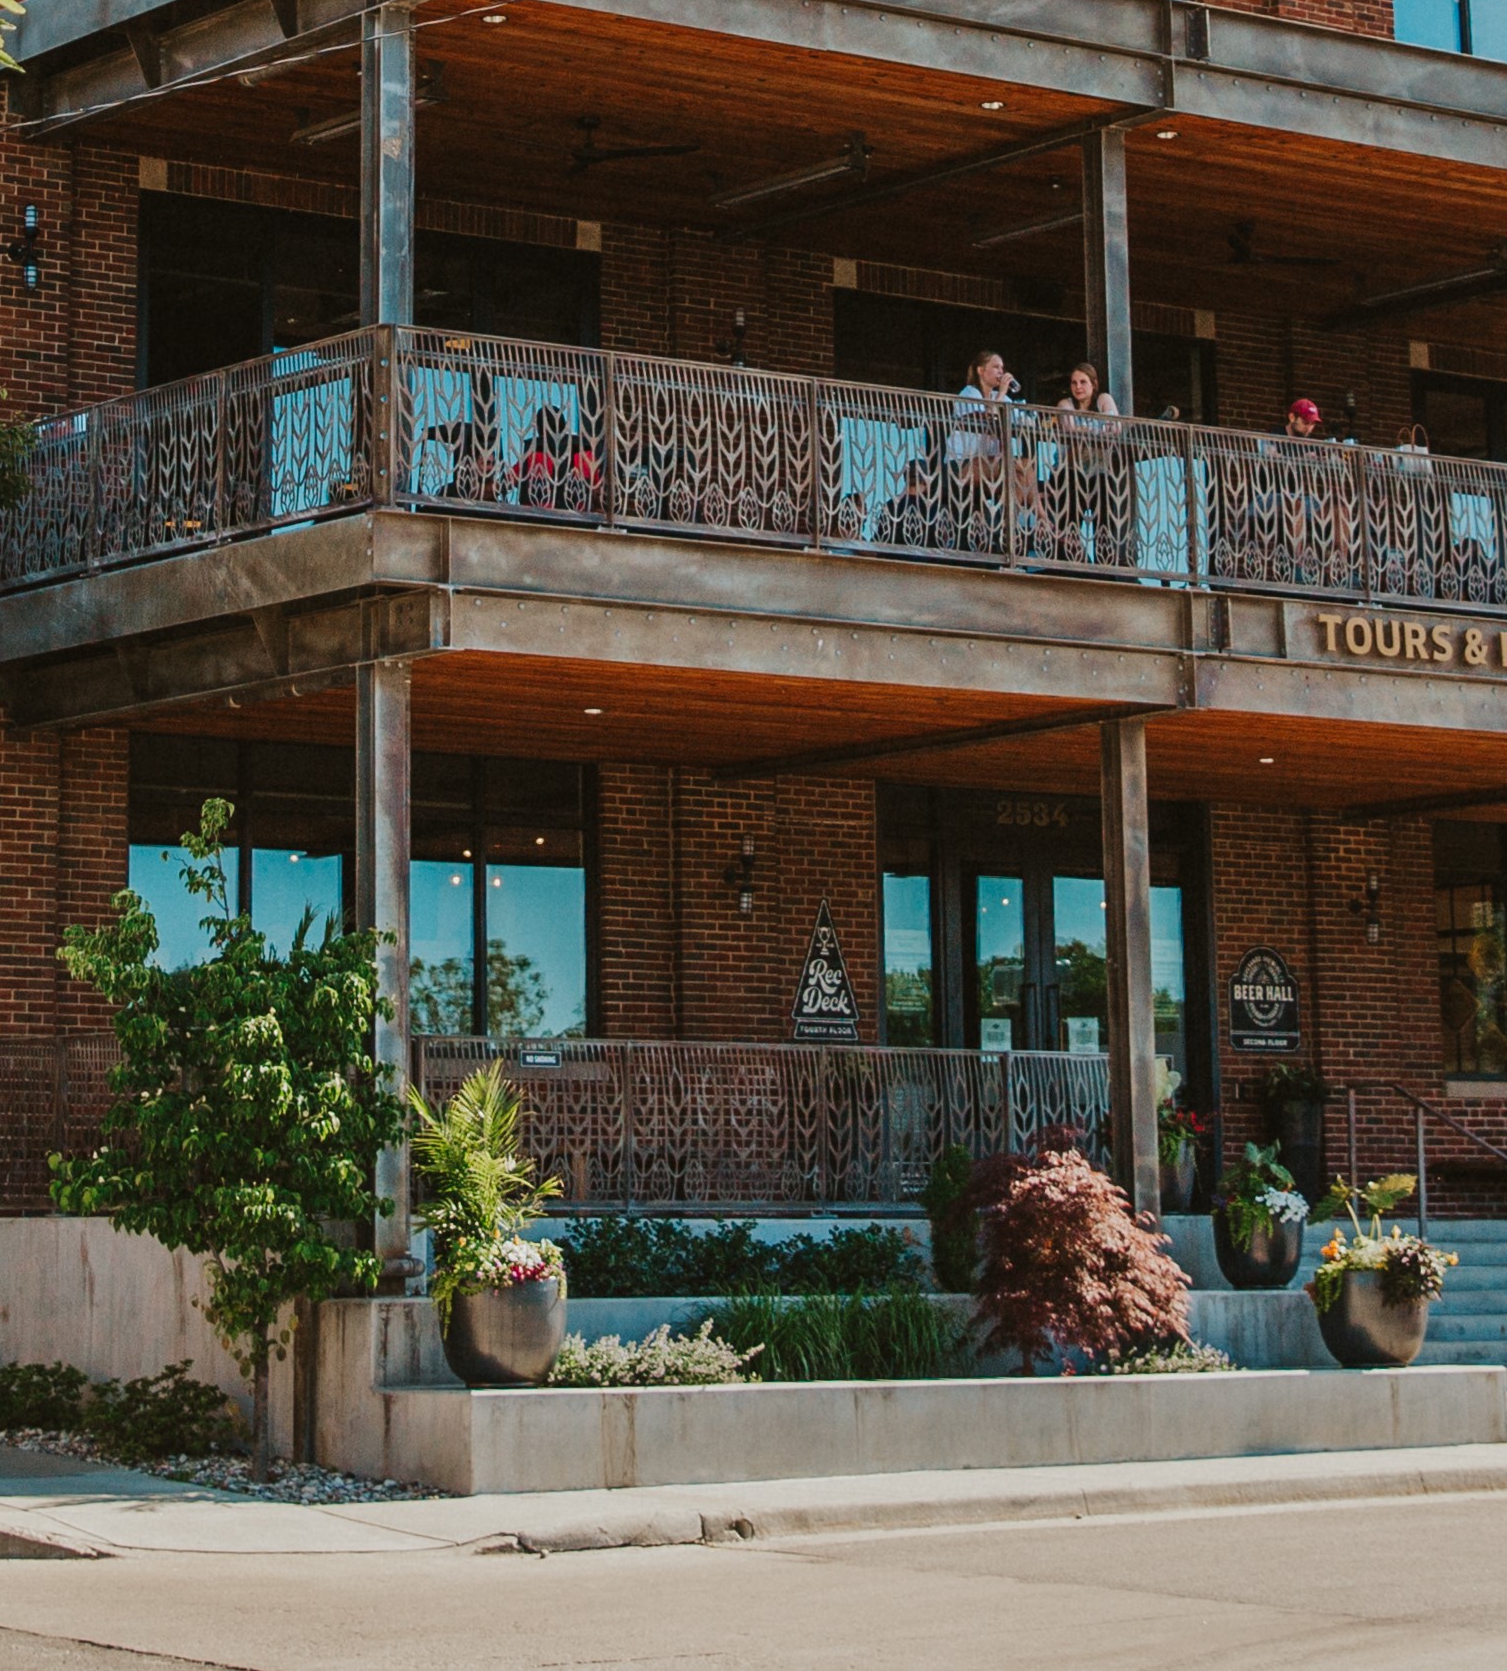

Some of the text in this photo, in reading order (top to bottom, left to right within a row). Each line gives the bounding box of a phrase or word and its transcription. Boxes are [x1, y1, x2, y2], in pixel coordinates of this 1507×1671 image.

[1318, 613, 1454, 662] TOURS
[1464, 628, 1489, 665] &
[996, 800, 1069, 828] 2534
[808, 958, 842, 994] Rec
[802, 986, 851, 1015] Deck
[1233, 984, 1294, 1002] BEER HALL
